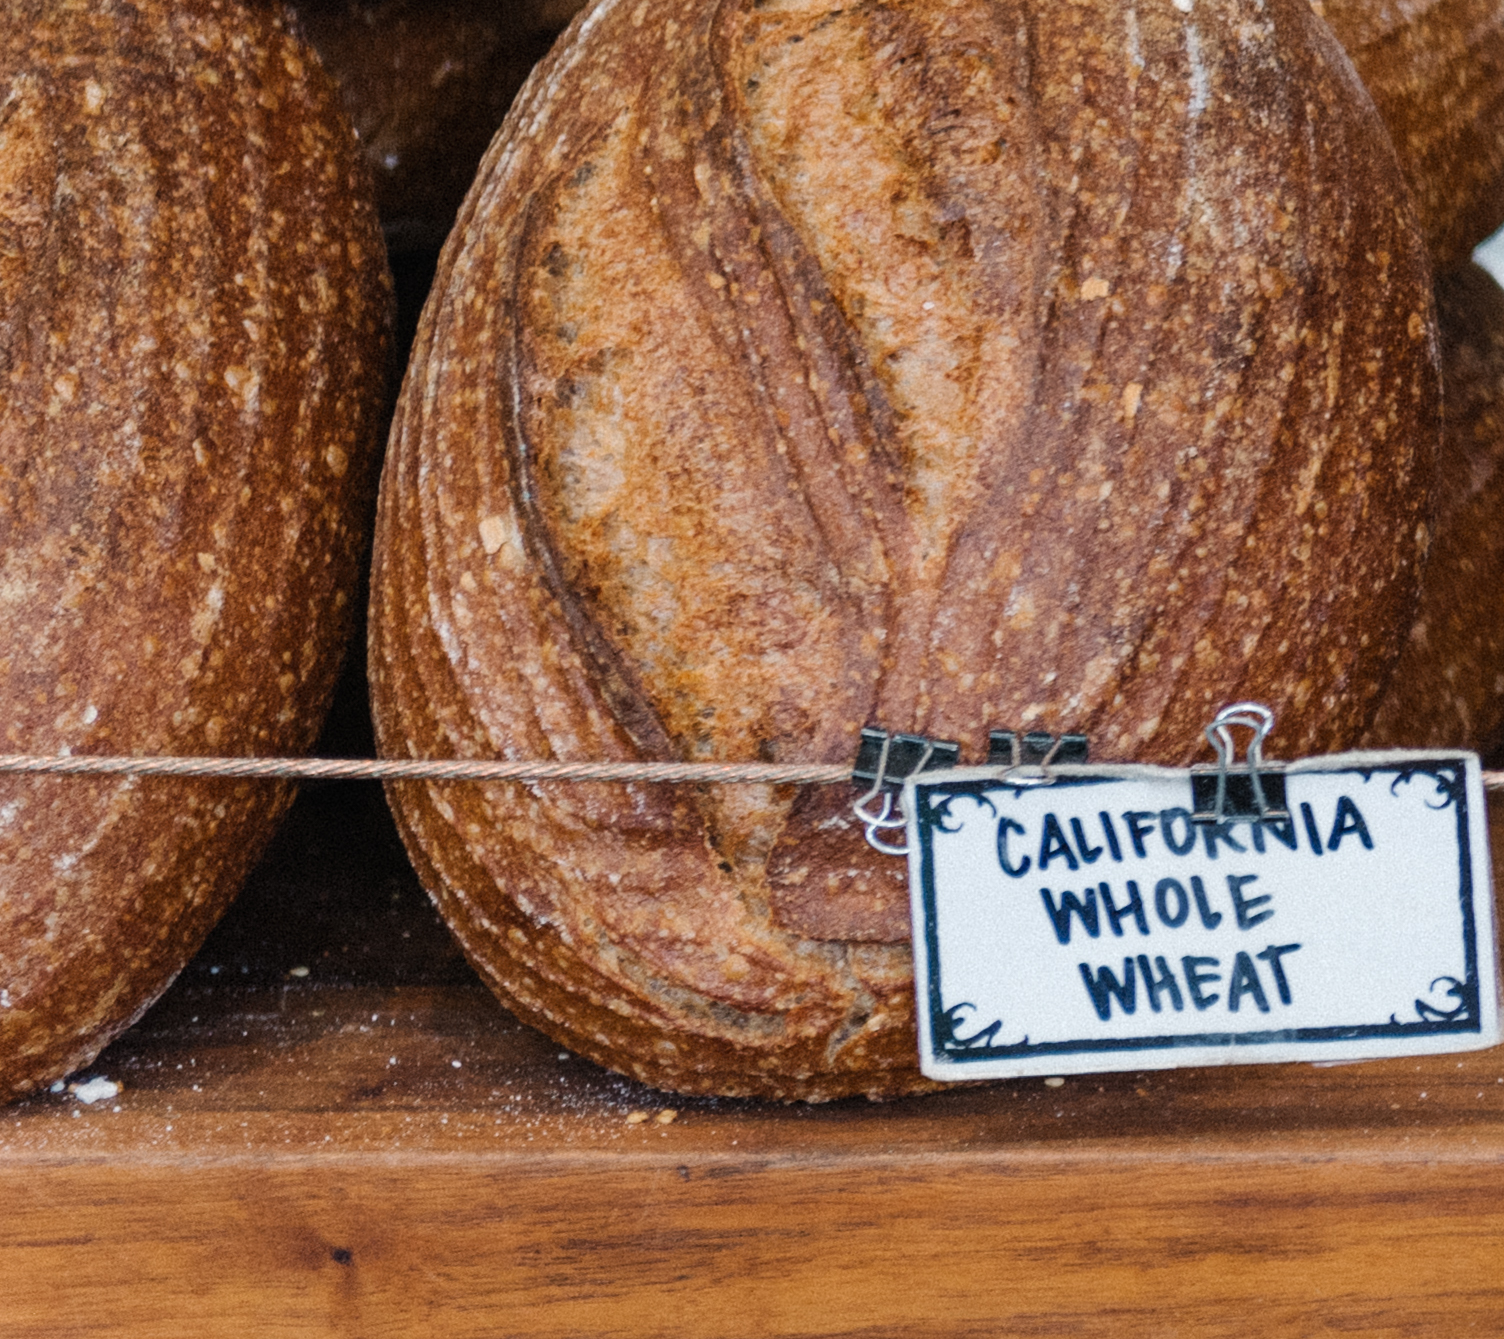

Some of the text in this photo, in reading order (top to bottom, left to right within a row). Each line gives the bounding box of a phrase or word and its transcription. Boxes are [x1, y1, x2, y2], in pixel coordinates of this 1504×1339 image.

[996, 795, 1374, 878] CALIFORNIA
[1040, 873, 1275, 945] WHOLE
[1078, 942, 1303, 1021] WHEAT
